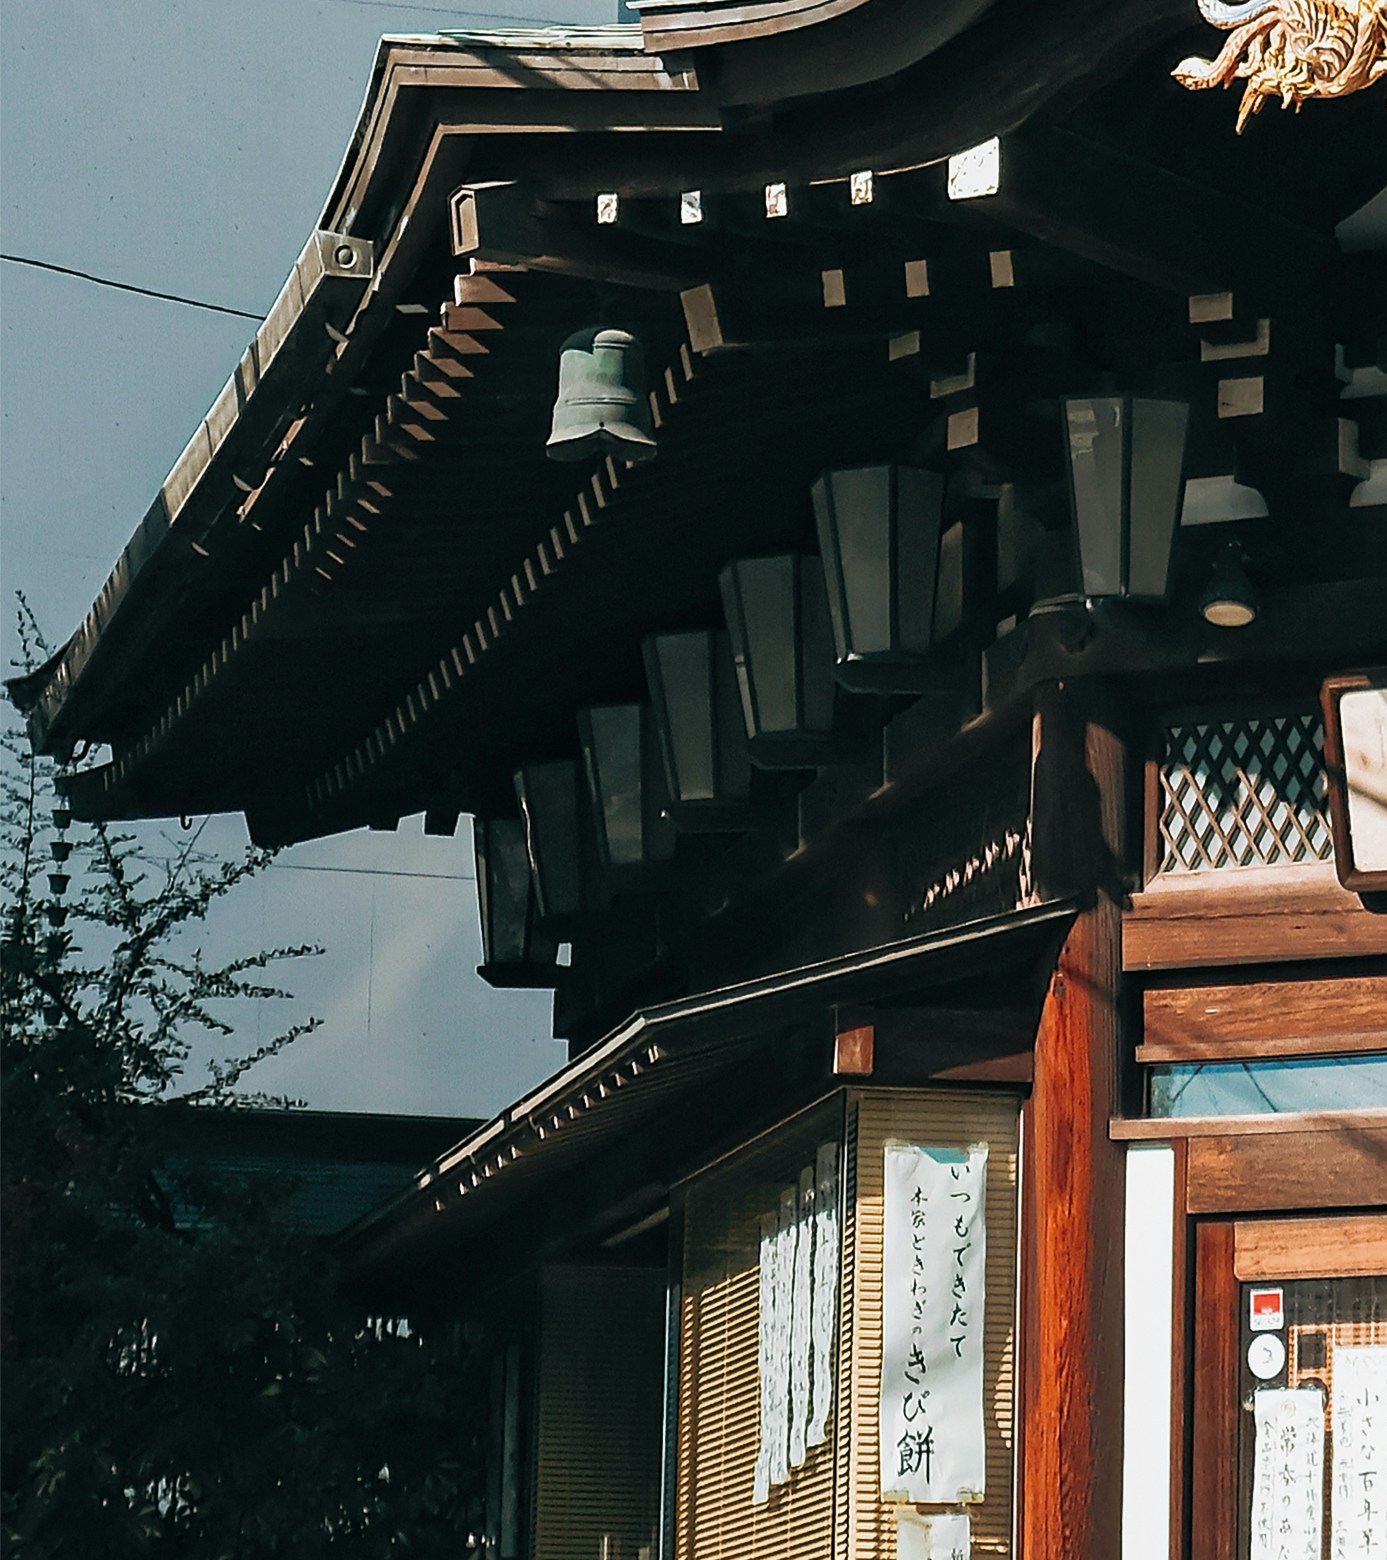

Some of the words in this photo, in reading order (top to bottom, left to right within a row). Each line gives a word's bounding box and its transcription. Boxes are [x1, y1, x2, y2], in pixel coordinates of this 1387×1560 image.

[949, 1165, 972, 1358] いつもできたて
